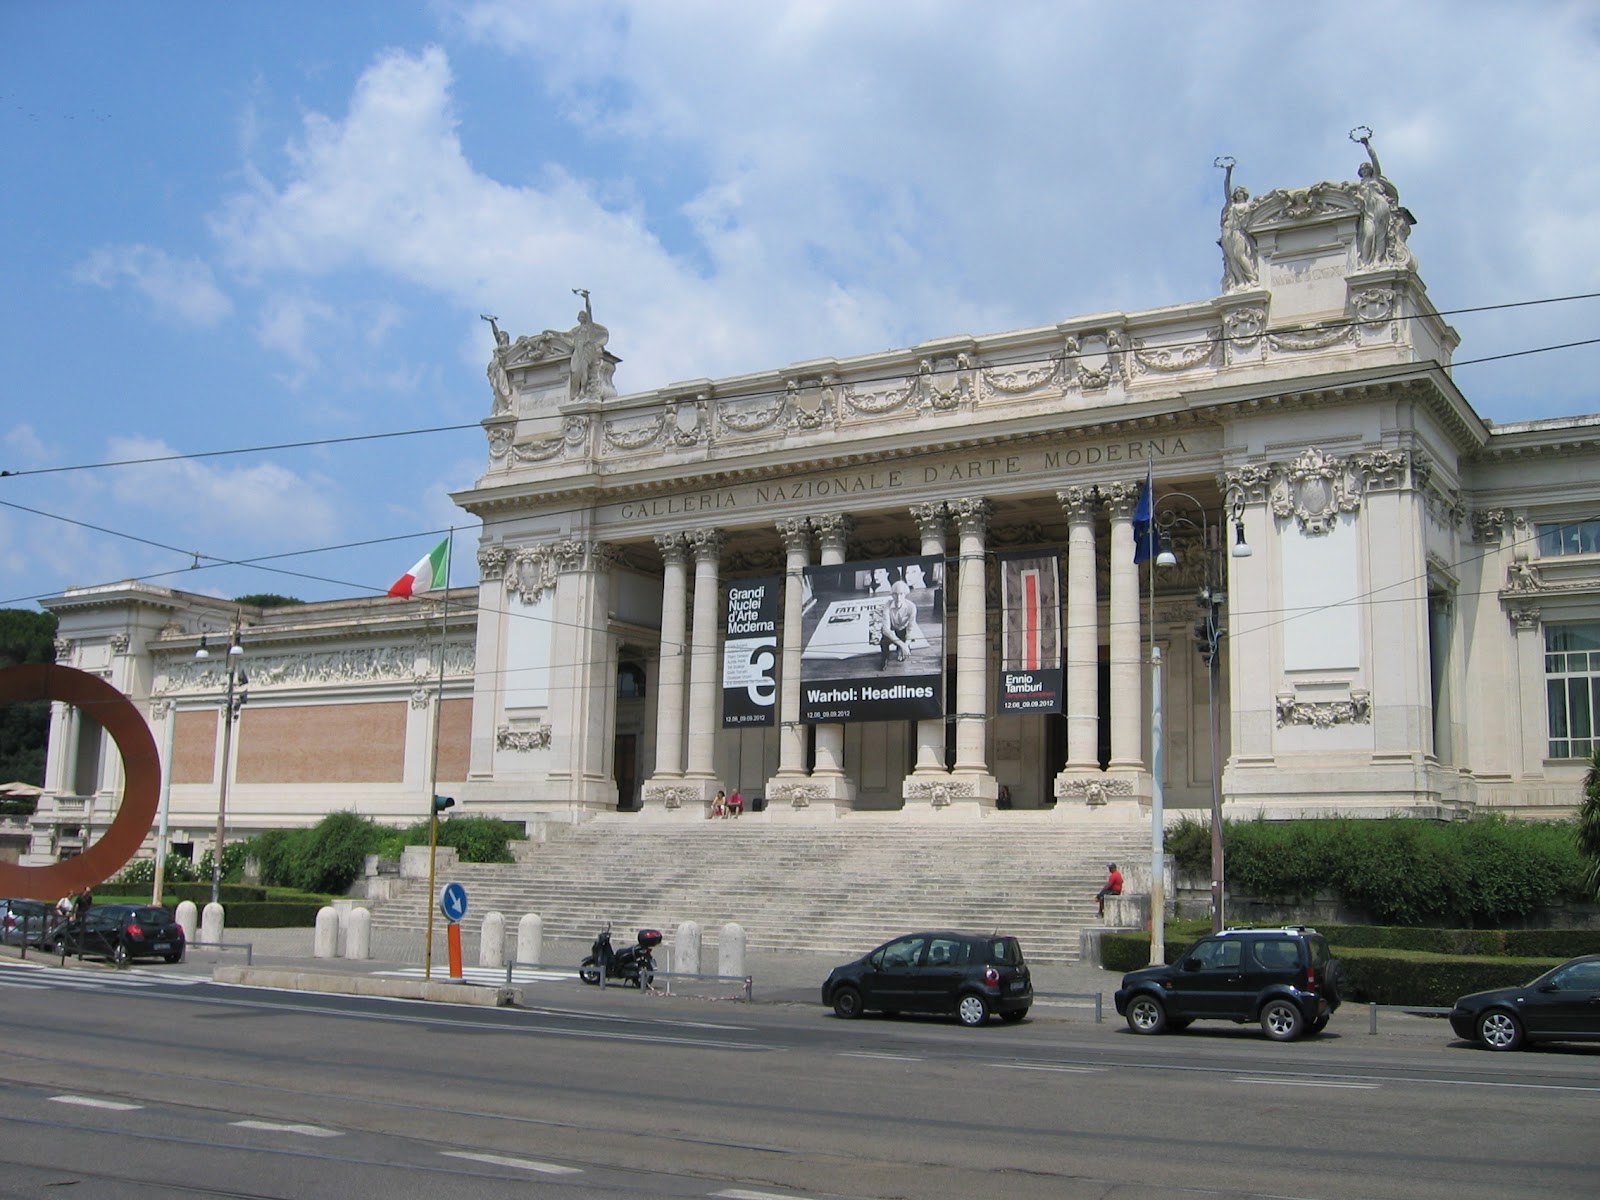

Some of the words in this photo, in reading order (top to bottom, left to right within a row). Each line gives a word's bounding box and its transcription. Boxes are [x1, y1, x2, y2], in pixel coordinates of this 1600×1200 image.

[621, 492, 736, 519] GALLERIA
[756, 470, 903, 503] NAZIONALE
[924, 456, 1021, 483] D'ARTE
[1044, 437, 1188, 469] MODERNA
[729, 586, 765, 600] Grandi
[728, 598, 761, 612] Nuclei
[728, 610, 759, 623] d'Arte
[728, 621, 775, 634] Moderna
[1005, 674, 1033, 684] Ennio
[807, 688, 858, 703] Warhol:
[862, 685, 933, 700] Headlines
[1005, 682, 1042, 693] Tamburi
